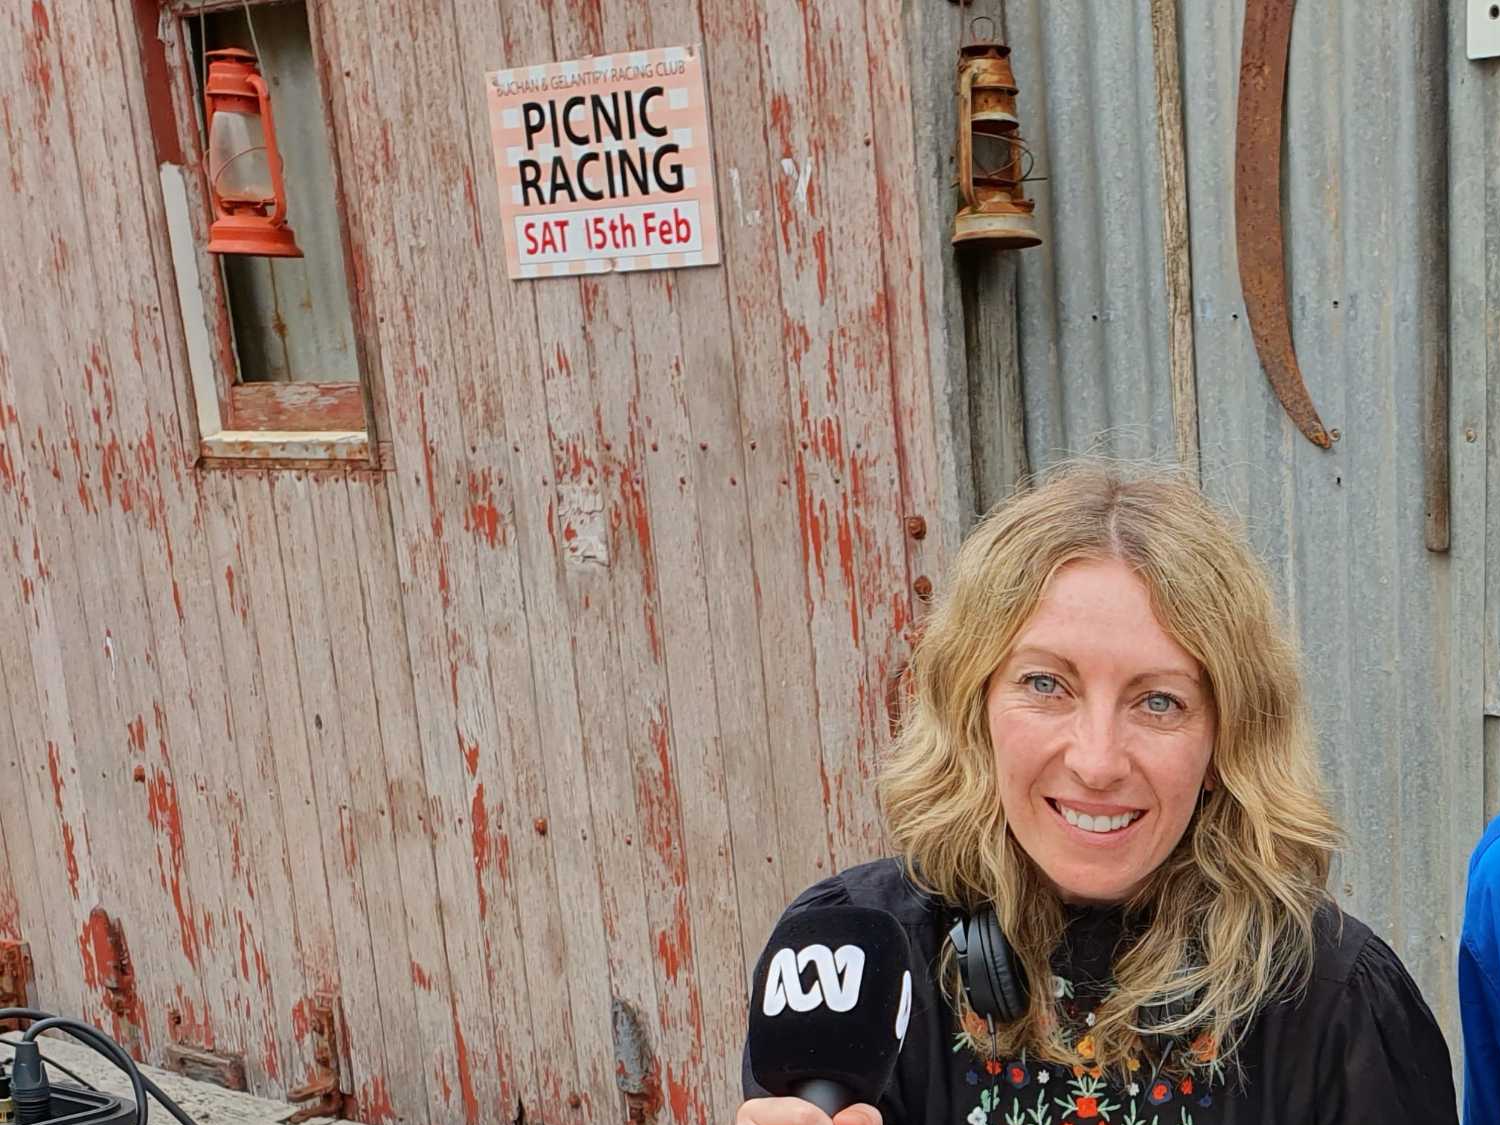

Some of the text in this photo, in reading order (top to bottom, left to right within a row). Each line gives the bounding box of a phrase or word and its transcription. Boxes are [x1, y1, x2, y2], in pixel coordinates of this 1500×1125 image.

[496, 60, 686, 97] BUCHAN & GELANTIPY RACING CLUB
[522, 86, 668, 151] PICNIC
[518, 143, 685, 207] RACING
[523, 207, 692, 256] SAT 15th Feb
